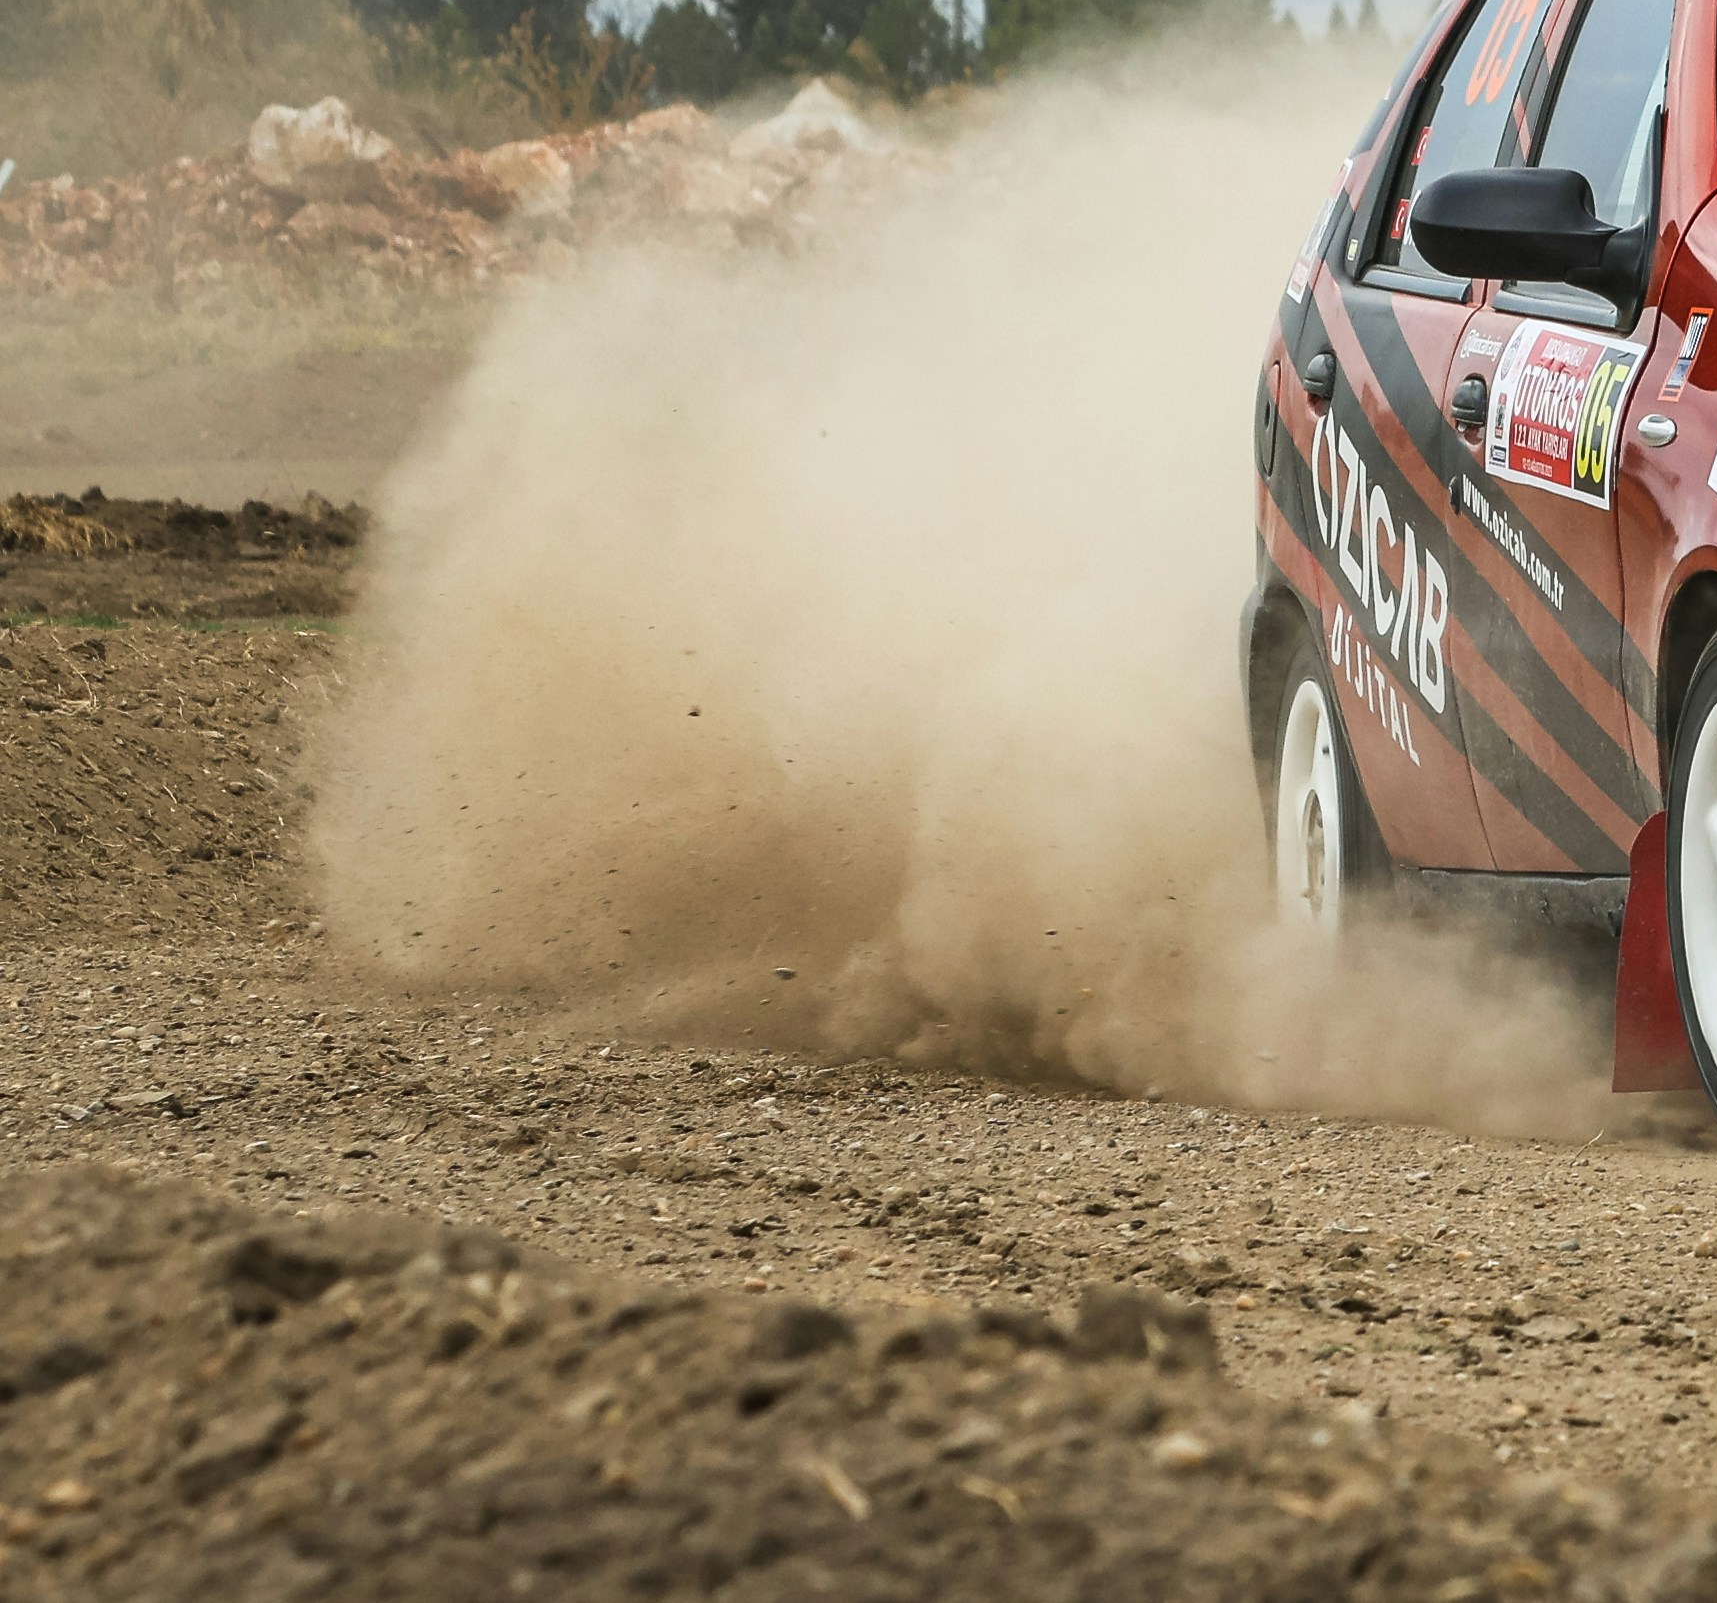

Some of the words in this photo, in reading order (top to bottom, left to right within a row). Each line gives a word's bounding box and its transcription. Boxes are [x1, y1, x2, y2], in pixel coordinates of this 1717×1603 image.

[1513, 363, 1585, 433] OTOKROS
[1576, 359, 1630, 484] 05
[1310, 406, 1449, 715] OZICAB
[1462, 473, 1565, 611] www.ozicab.com.tr
